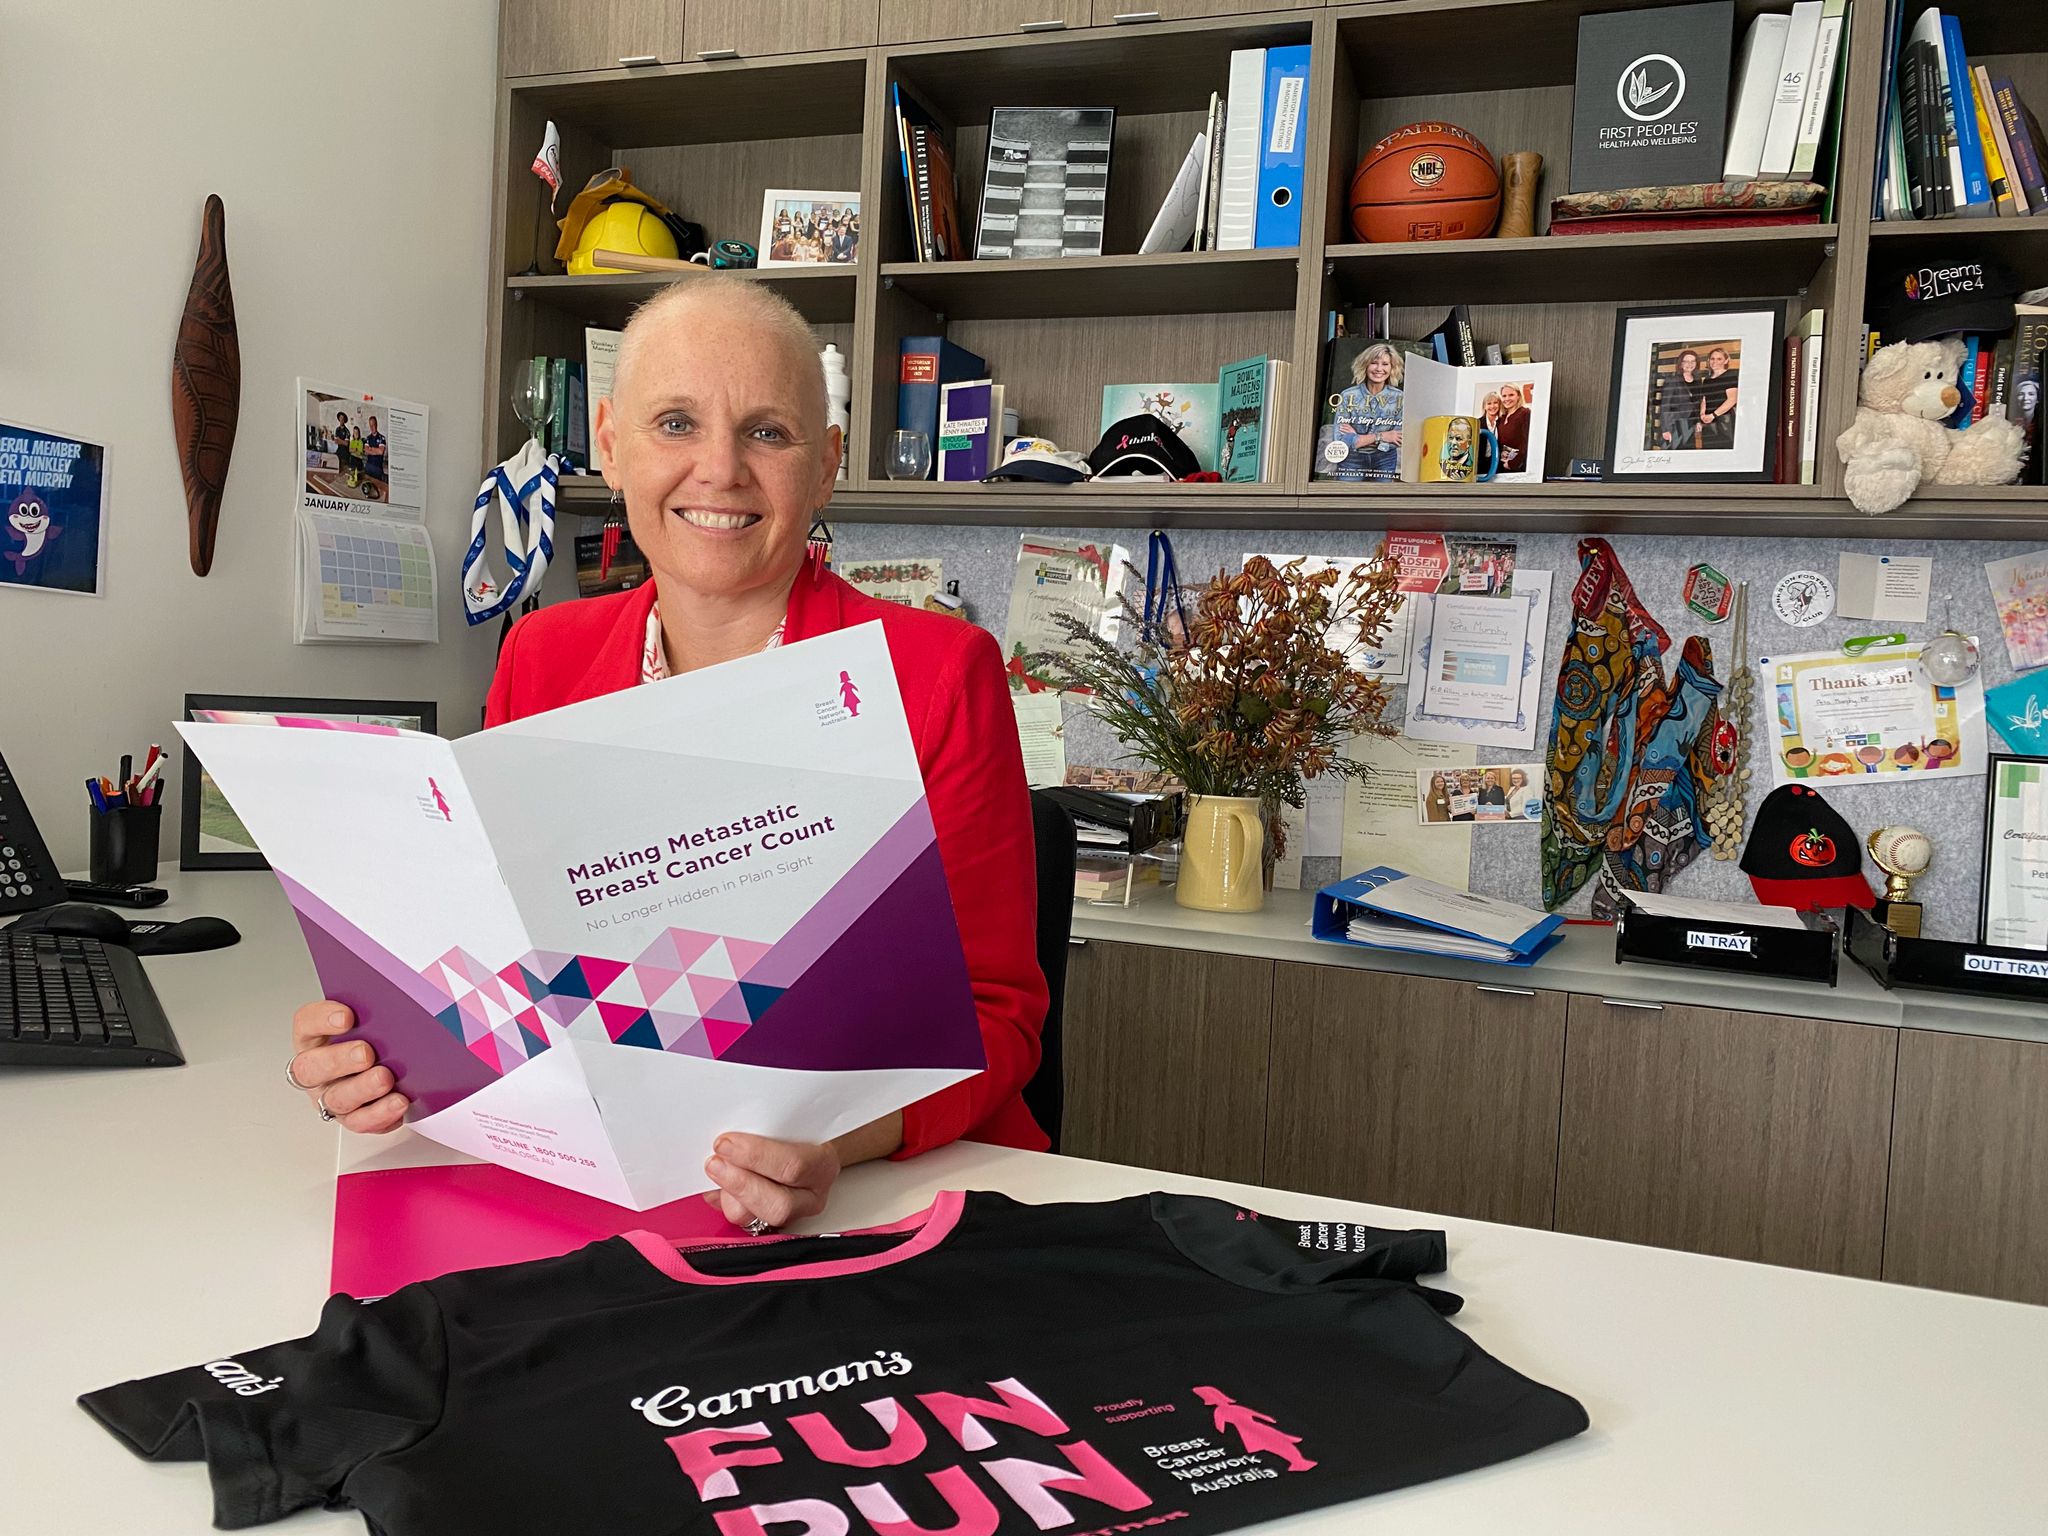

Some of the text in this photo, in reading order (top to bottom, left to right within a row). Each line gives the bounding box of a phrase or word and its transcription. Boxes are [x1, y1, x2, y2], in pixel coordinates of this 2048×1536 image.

[1290, 80, 1300, 113] FRANKSTON
[1277, 119, 1286, 149] MEETINGS
[1284, 126, 1293, 151] COUNCIL
[1374, 123, 1483, 155] SPALDING
[1599, 126, 1635, 140] FIRST
[1599, 135, 1697, 149] HEALTH AND WELLBEING
[915, 130, 930, 201] BLACK SUMMER
[1417, 162, 1438, 176] NBL
[1918, 264, 1983, 288] Dreams
[1922, 272, 1985, 300] 2Live4
[1236, 369, 1255, 384] BOWL
[1998, 383, 2004, 391] to
[1231, 379, 1261, 398] MAIDENS
[1241, 391, 1259, 406] OVER
[1971, 368, 1987, 422] IMPEACH
[943, 426, 984, 436] JENNY MACKLIN
[957, 420, 980, 428] THWAITES
[1337, 415, 1374, 427] Don't Stop
[0, 437, 82, 459] ERAL MEMBER
[1128, 432, 1157, 446] think
[0, 453, 73, 473] OR DUNKLEY
[0, 469, 74, 489] ETA MURPHY
[304, 497, 372, 515] JANUARY 2023
[1390, 545, 1418, 555] EMIL
[1398, 568, 1441, 578] ESERVE
[1399, 557, 1438, 568] ADSEN
[1776, 574, 1831, 617] FRANKSTON FOOTBALL
[1802, 611, 1824, 622] CLUB
[1808, 674, 1868, 691] Thank
[566, 803, 800, 885] Making Metastatic
[575, 815, 836, 907] Breast Cancer Count
[2031, 869, 2048, 879] Pet
[586, 854, 813, 933] No Longer Hidden in Plain Sight
[1690, 933, 1748, 950] IN TRAY
[1968, 958, 2048, 976] OUT TRAY
[485, 1132, 597, 1169] HELPLINE 1800 500 258
[1297, 1224, 1311, 1249] Breast
[1315, 1221, 1329, 1250] Cancer
[1333, 1223, 1347, 1252] Netwo
[1352, 1225, 1366, 1253] Austra
[630, 1350, 914, 1428] Carman's
[1093, 1398, 1145, 1414] Proudly
[1104, 1403, 1176, 1425] supporting
[664, 1377, 1071, 1502] FUN
[1142, 1436, 1212, 1459] Breast
[1156, 1446, 1226, 1471] Cancer
[1170, 1454, 1263, 1482] Network
[1189, 1467, 1279, 1496] Australia
